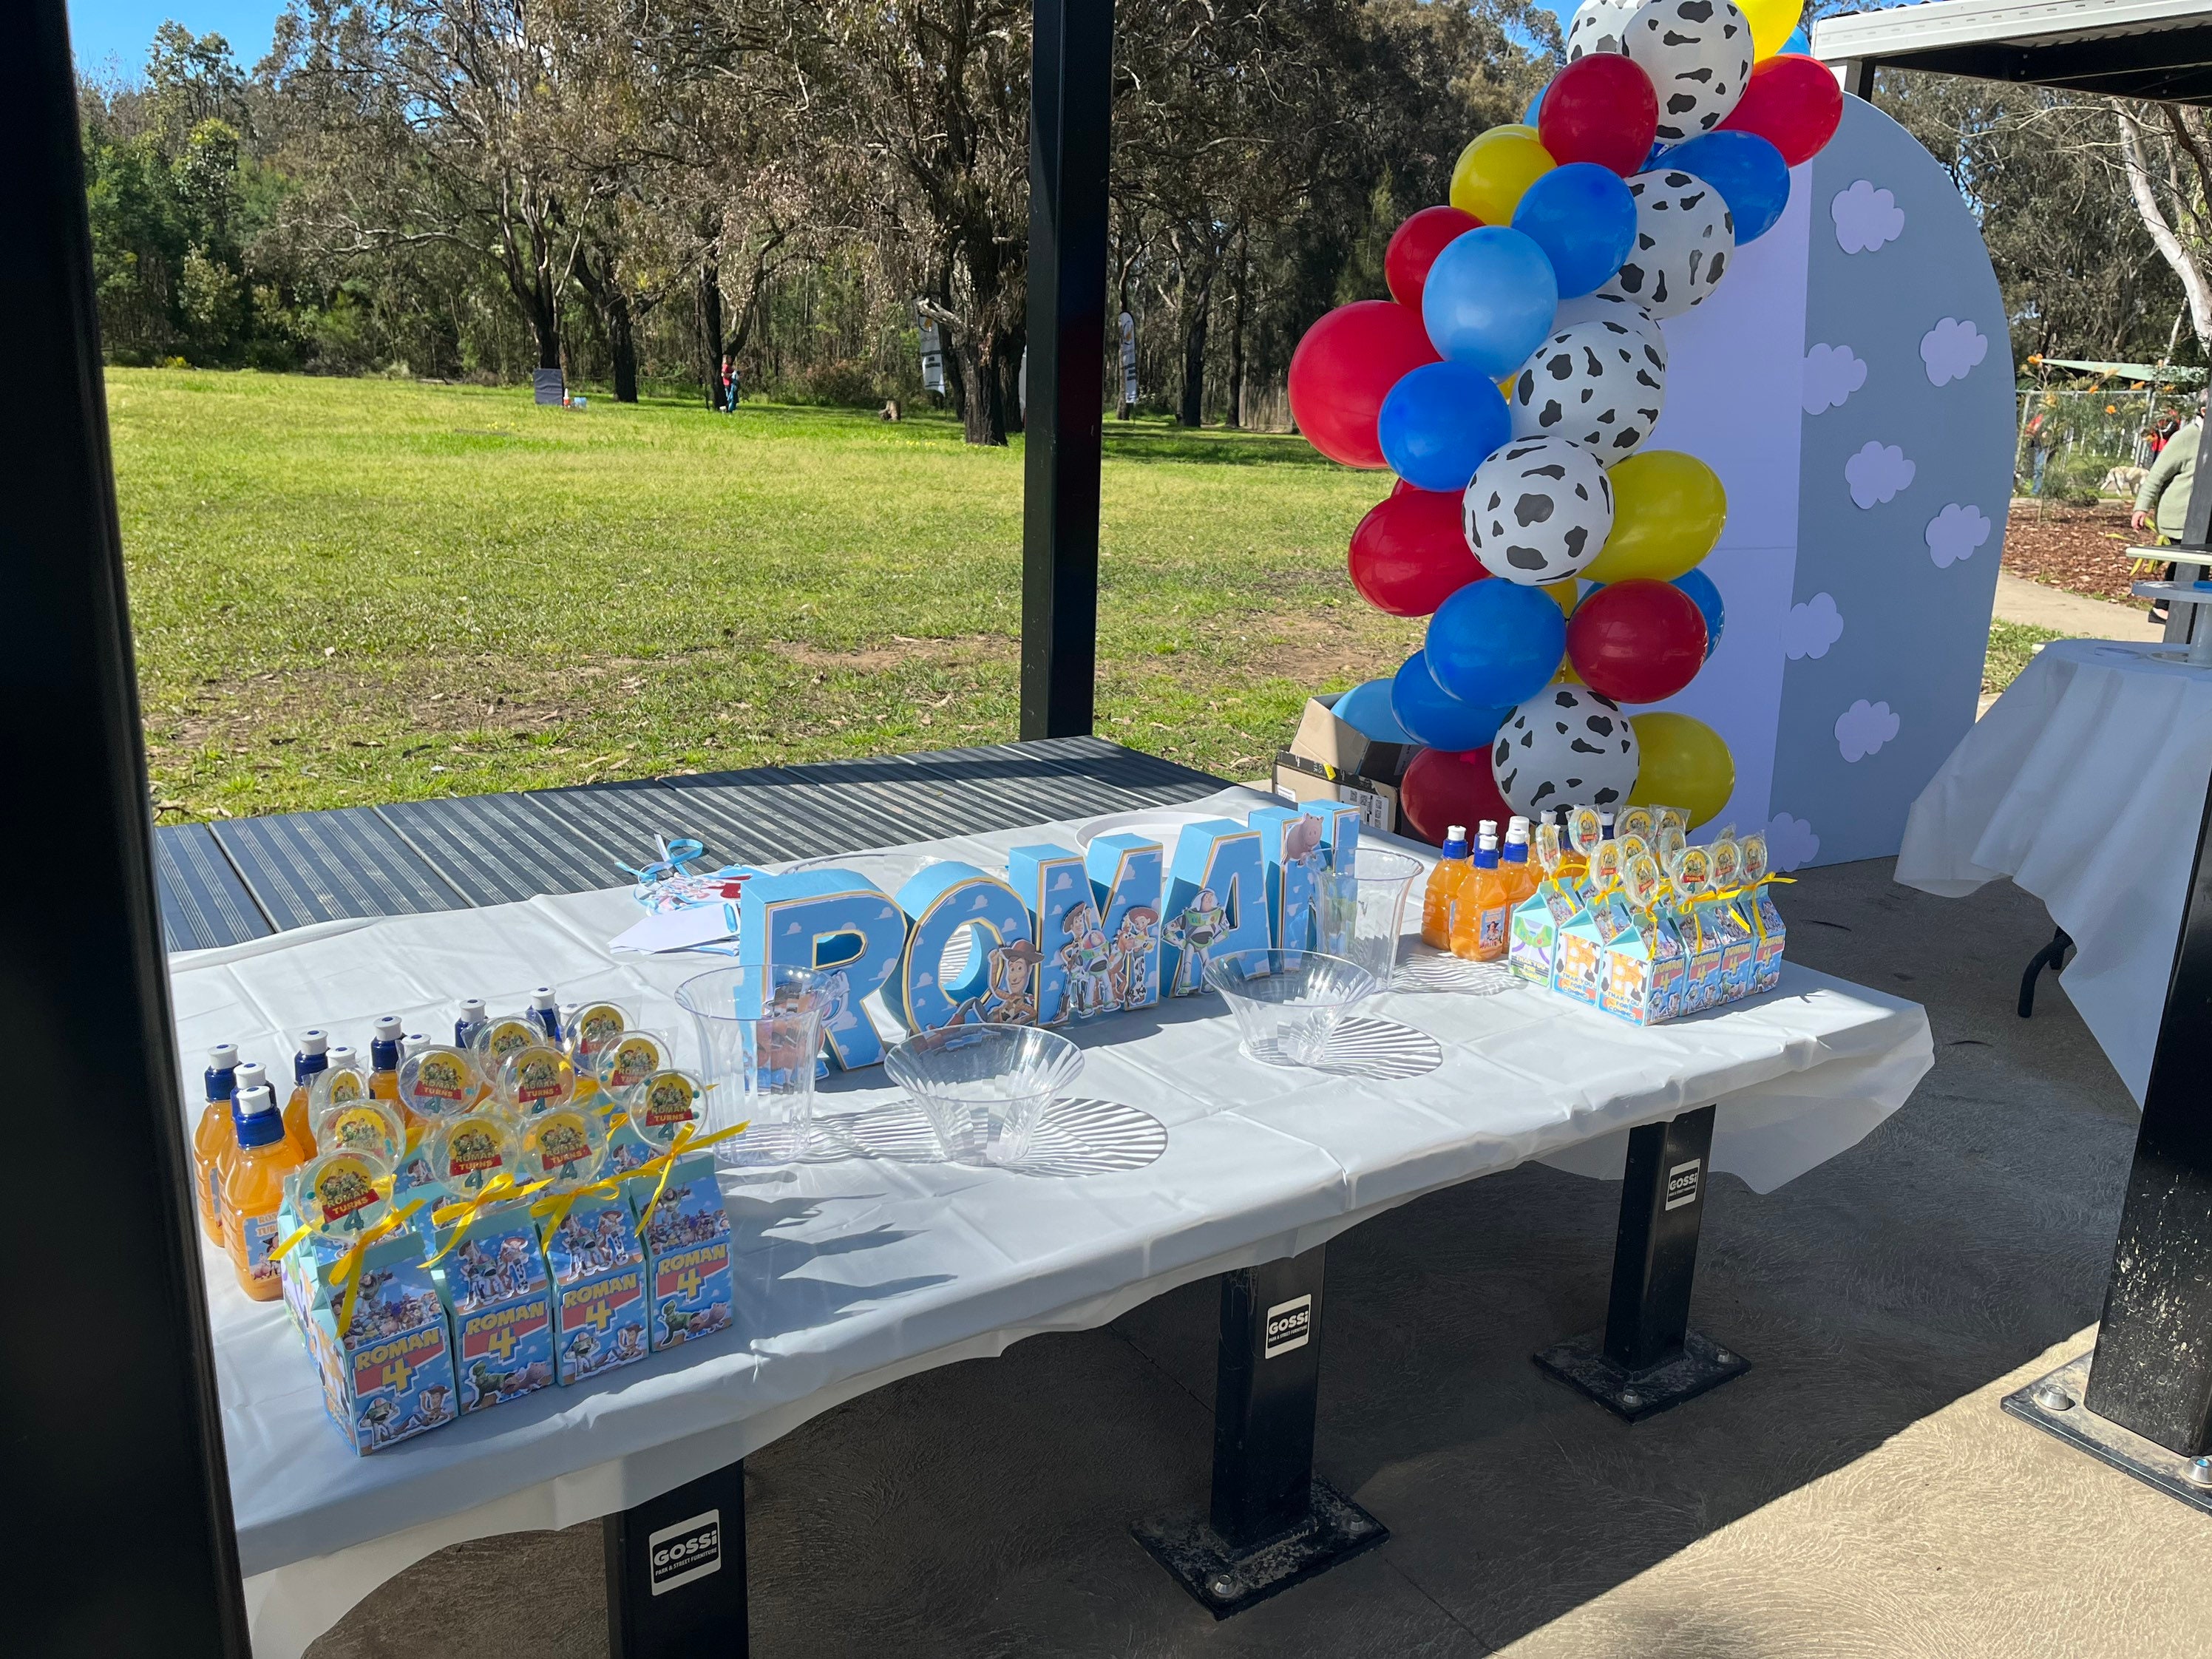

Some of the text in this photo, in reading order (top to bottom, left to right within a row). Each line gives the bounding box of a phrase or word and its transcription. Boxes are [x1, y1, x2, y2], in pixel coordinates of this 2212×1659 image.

[1729, 956, 1738, 975] 4
[1763, 948, 1771, 967] 4
[1660, 973, 1670, 992] 4
[1697, 966, 1707, 985] 4
[658, 1121, 675, 1141] 4
[464, 1170, 484, 1190] 4
[333, 1195, 369, 1215] TURNS
[343, 1209, 364, 1232] 4
[659, 1244, 726, 1276] ROMAN
[564, 1272, 637, 1309] ROMAN
[676, 1268, 702, 1299] 4
[467, 1301, 545, 1335] ROMAN
[585, 1300, 612, 1331] 4
[356, 1329, 440, 1371] ROMAN
[488, 1327, 517, 1359] 4
[381, 1358, 413, 1392] 4
[655, 1566, 668, 1576] PARK
[673, 1557, 691, 1569] STREET
[691, 1547, 717, 1562] FURNITURE
